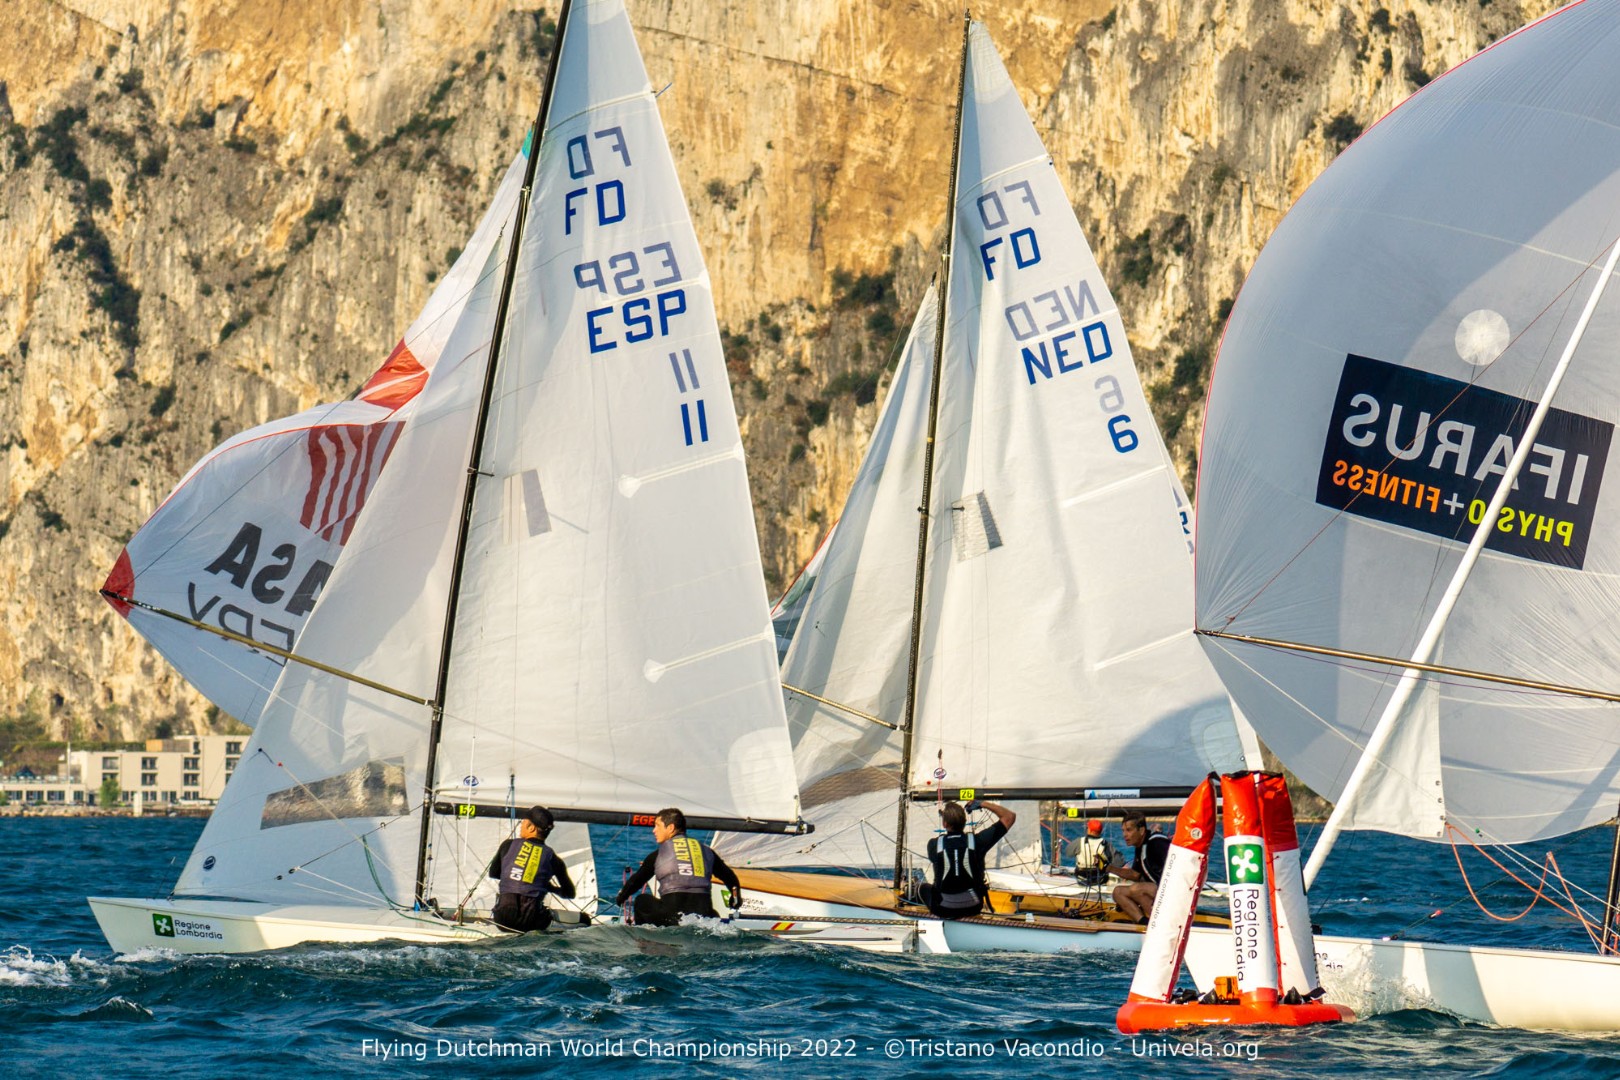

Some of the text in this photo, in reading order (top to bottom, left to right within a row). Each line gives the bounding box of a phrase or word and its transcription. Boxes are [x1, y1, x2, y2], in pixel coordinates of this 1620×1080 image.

[565, 179, 626, 235] FD
[979, 227, 1041, 282] FD
[586, 289, 687, 354] ESP
[1020, 320, 1113, 385] NED
[680, 399, 709, 446] 11
[1107, 414, 1139, 454] 6
[510, 867, 523, 881] CN
[672, 837, 693, 876] CN ALTEA
[174, 919, 211, 930] Regione
[175, 928, 223, 939] Lombardia
[1233, 889, 1245, 981] Lombardia
[1244, 889, 1260, 959] Regione
